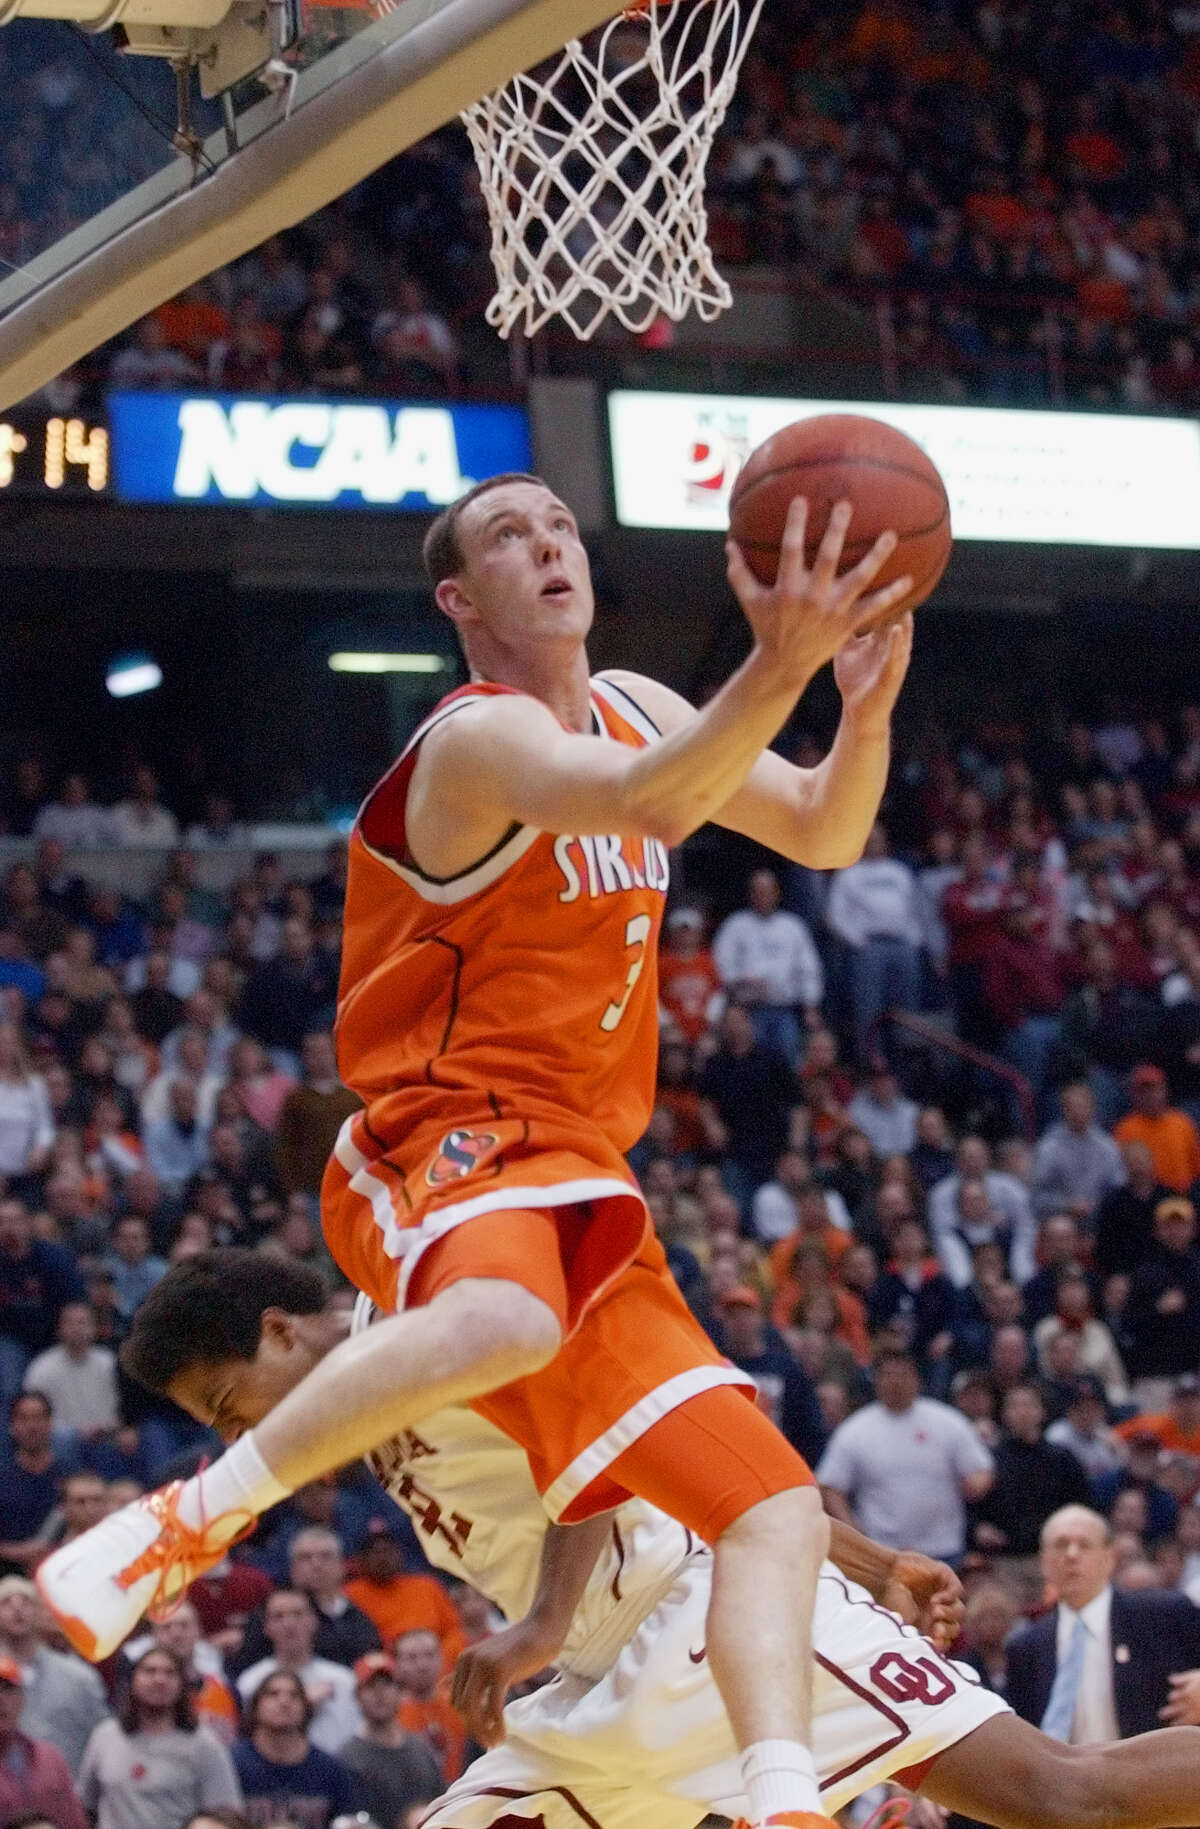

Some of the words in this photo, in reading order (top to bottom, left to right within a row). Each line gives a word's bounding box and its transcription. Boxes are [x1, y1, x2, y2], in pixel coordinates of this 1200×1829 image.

[44, 417, 108, 491] 14
[173, 398, 468, 505] NCAA
[870, 1652, 956, 1705] OU
